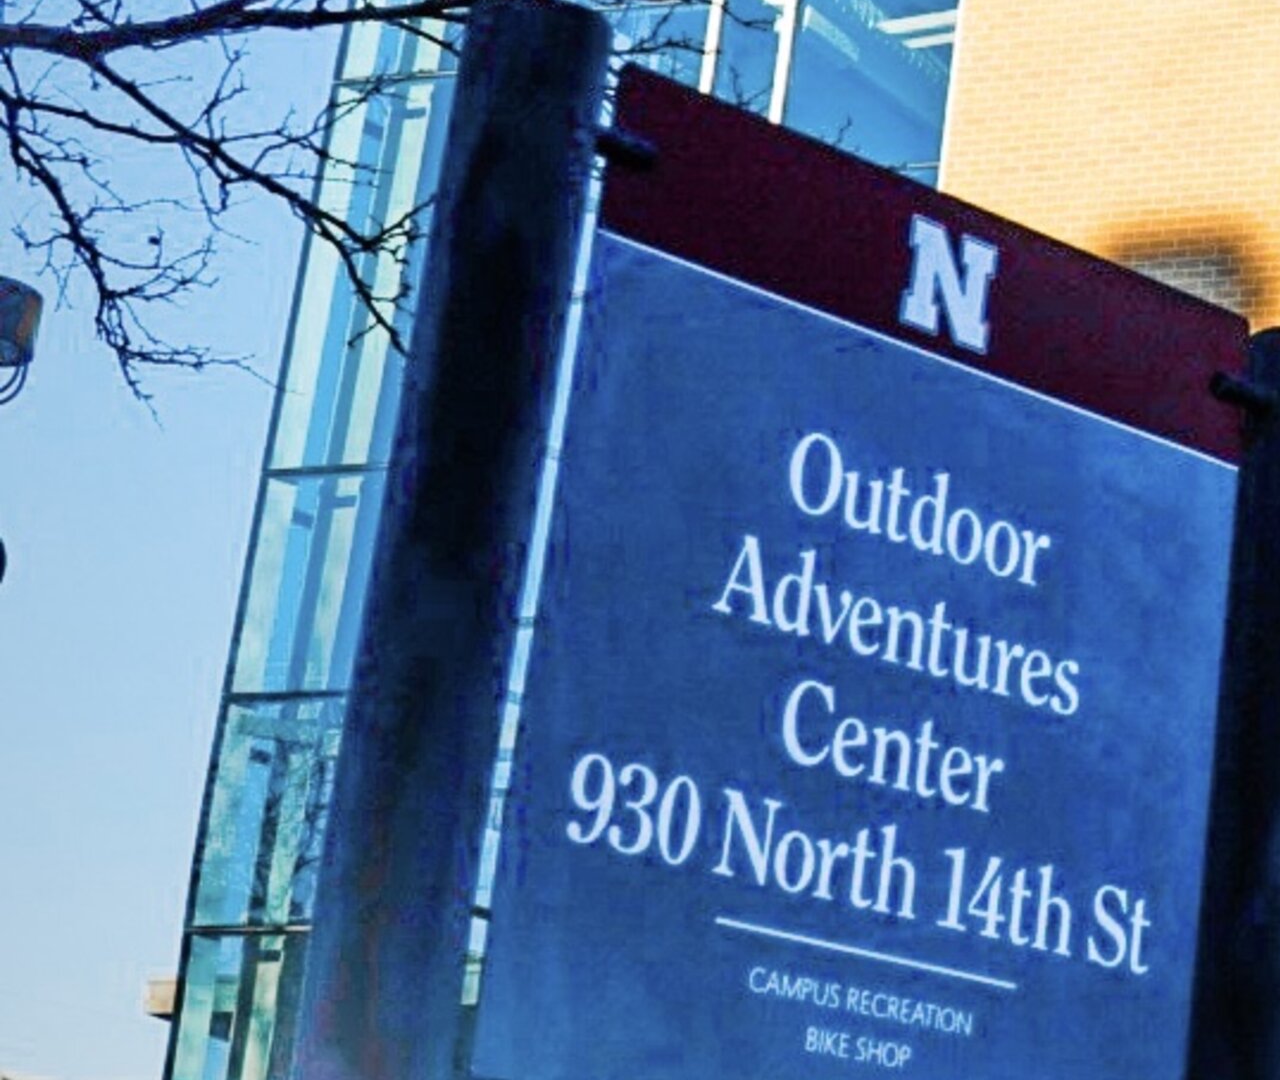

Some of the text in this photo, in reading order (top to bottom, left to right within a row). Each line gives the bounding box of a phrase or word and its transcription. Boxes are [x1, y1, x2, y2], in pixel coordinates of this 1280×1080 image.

[904, 213, 998, 355] N
[788, 432, 1052, 587] Outdoor
[711, 534, 1080, 716] Adventures
[782, 679, 1006, 813] Center
[565, 752, 1151, 975] 930 North 14th St
[748, 966, 974, 1036] CAMPUS RECREATION
[804, 1026, 912, 1069] BIKE SHOP
